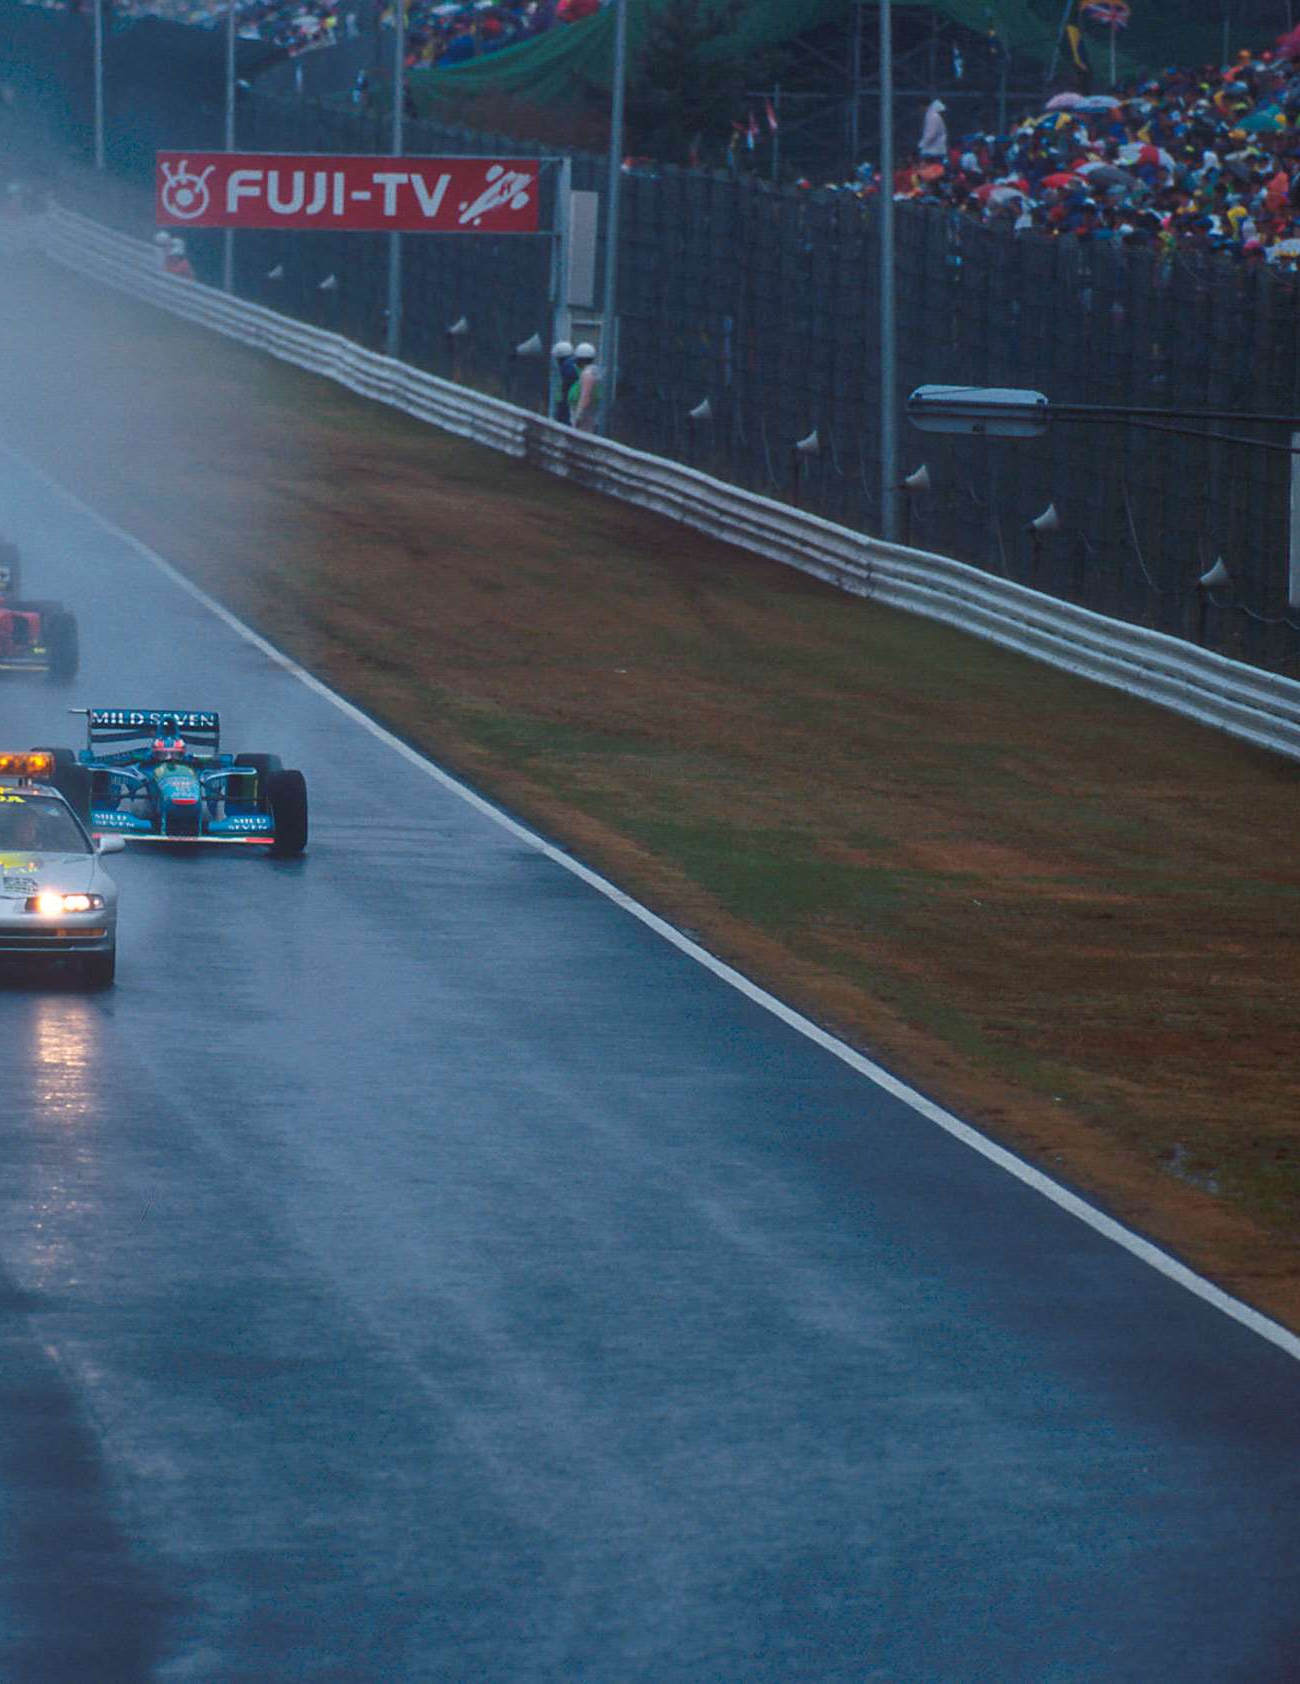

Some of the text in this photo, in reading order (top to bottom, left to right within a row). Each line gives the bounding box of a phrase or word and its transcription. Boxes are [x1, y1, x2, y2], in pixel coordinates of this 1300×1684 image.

[226, 169, 451, 217] FUJI-TV
[91, 711, 215, 727] MILD SEVEN
[93, 812, 127, 821] MILD
